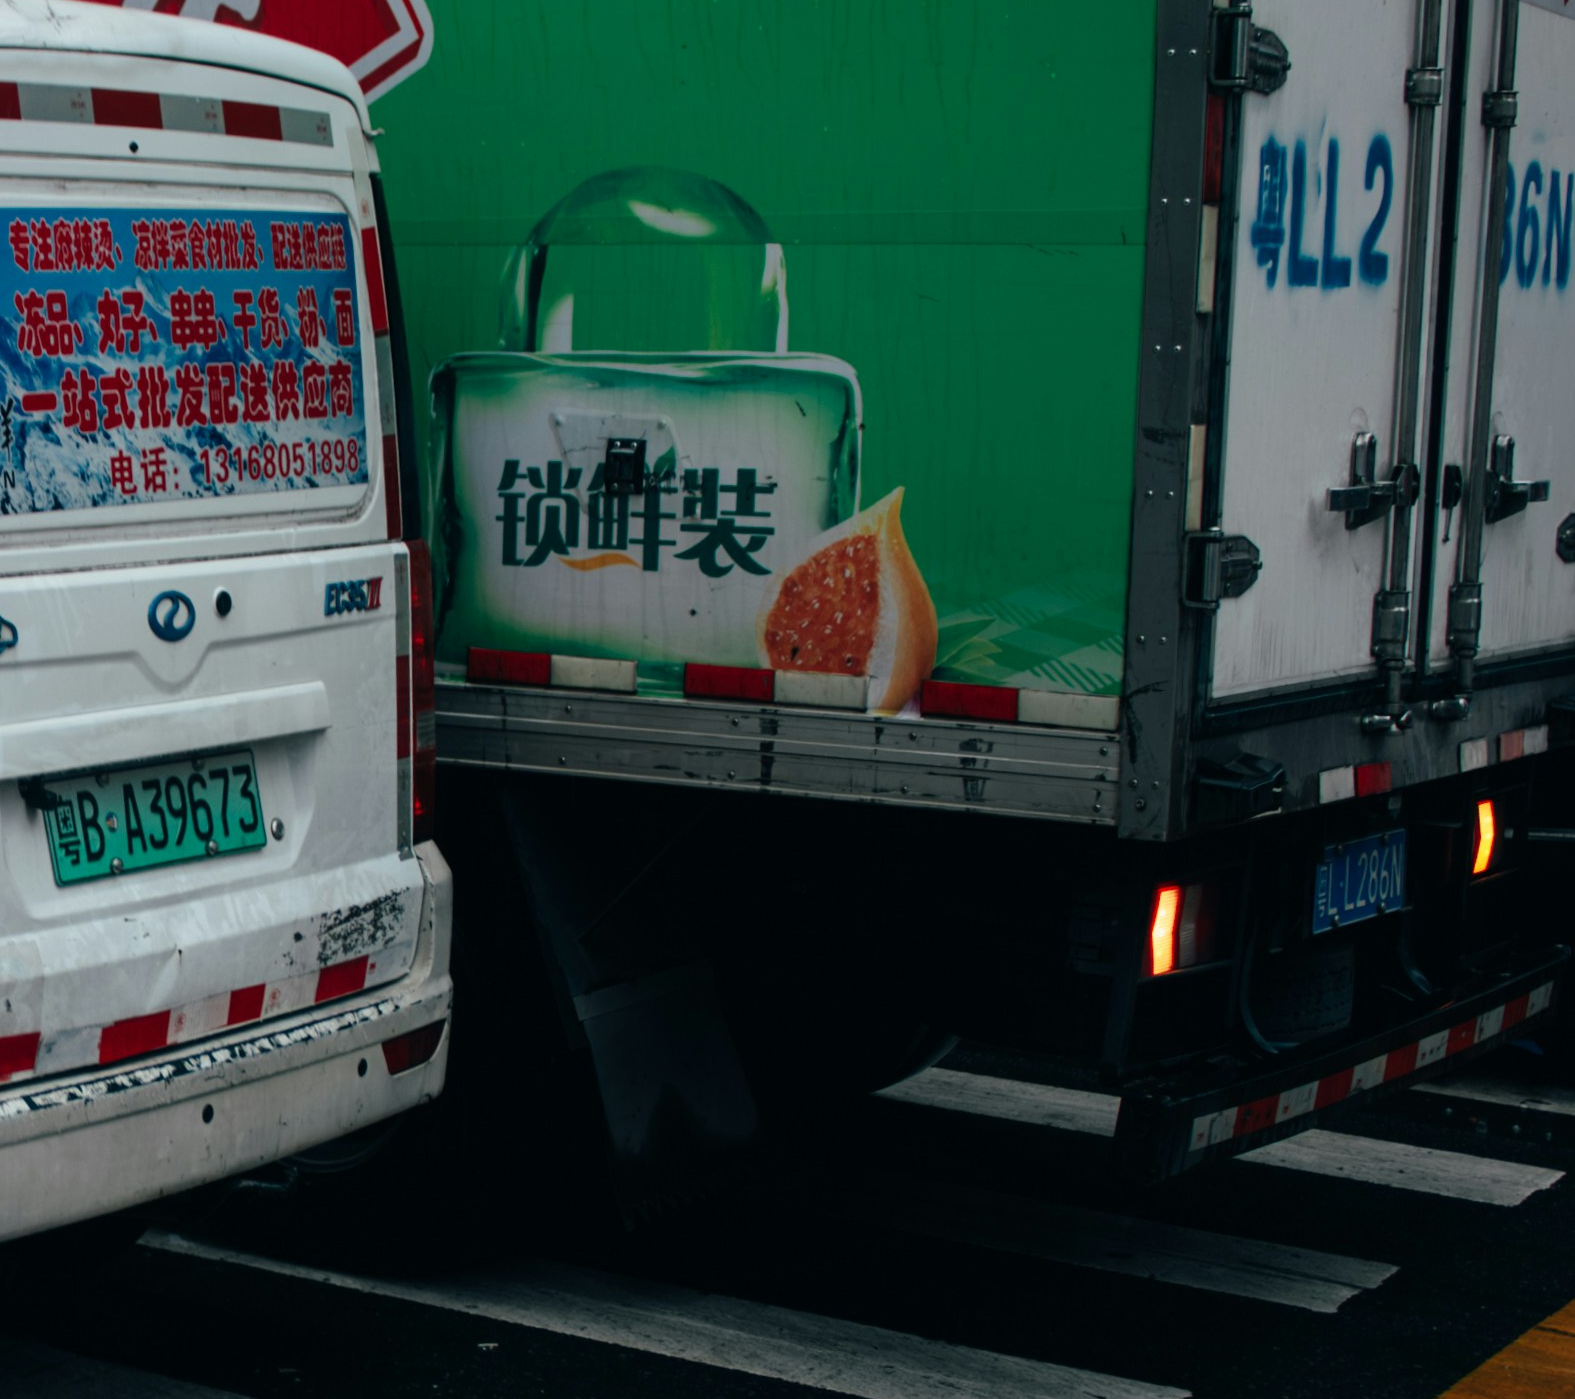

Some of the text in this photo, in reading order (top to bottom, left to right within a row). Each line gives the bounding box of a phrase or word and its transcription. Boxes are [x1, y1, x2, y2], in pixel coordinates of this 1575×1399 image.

[21, 358, 354, 433] 一站式批发配送供应商
[199, 438, 361, 487] 13168051898
[495, 459, 778, 578] 锁鲜装
